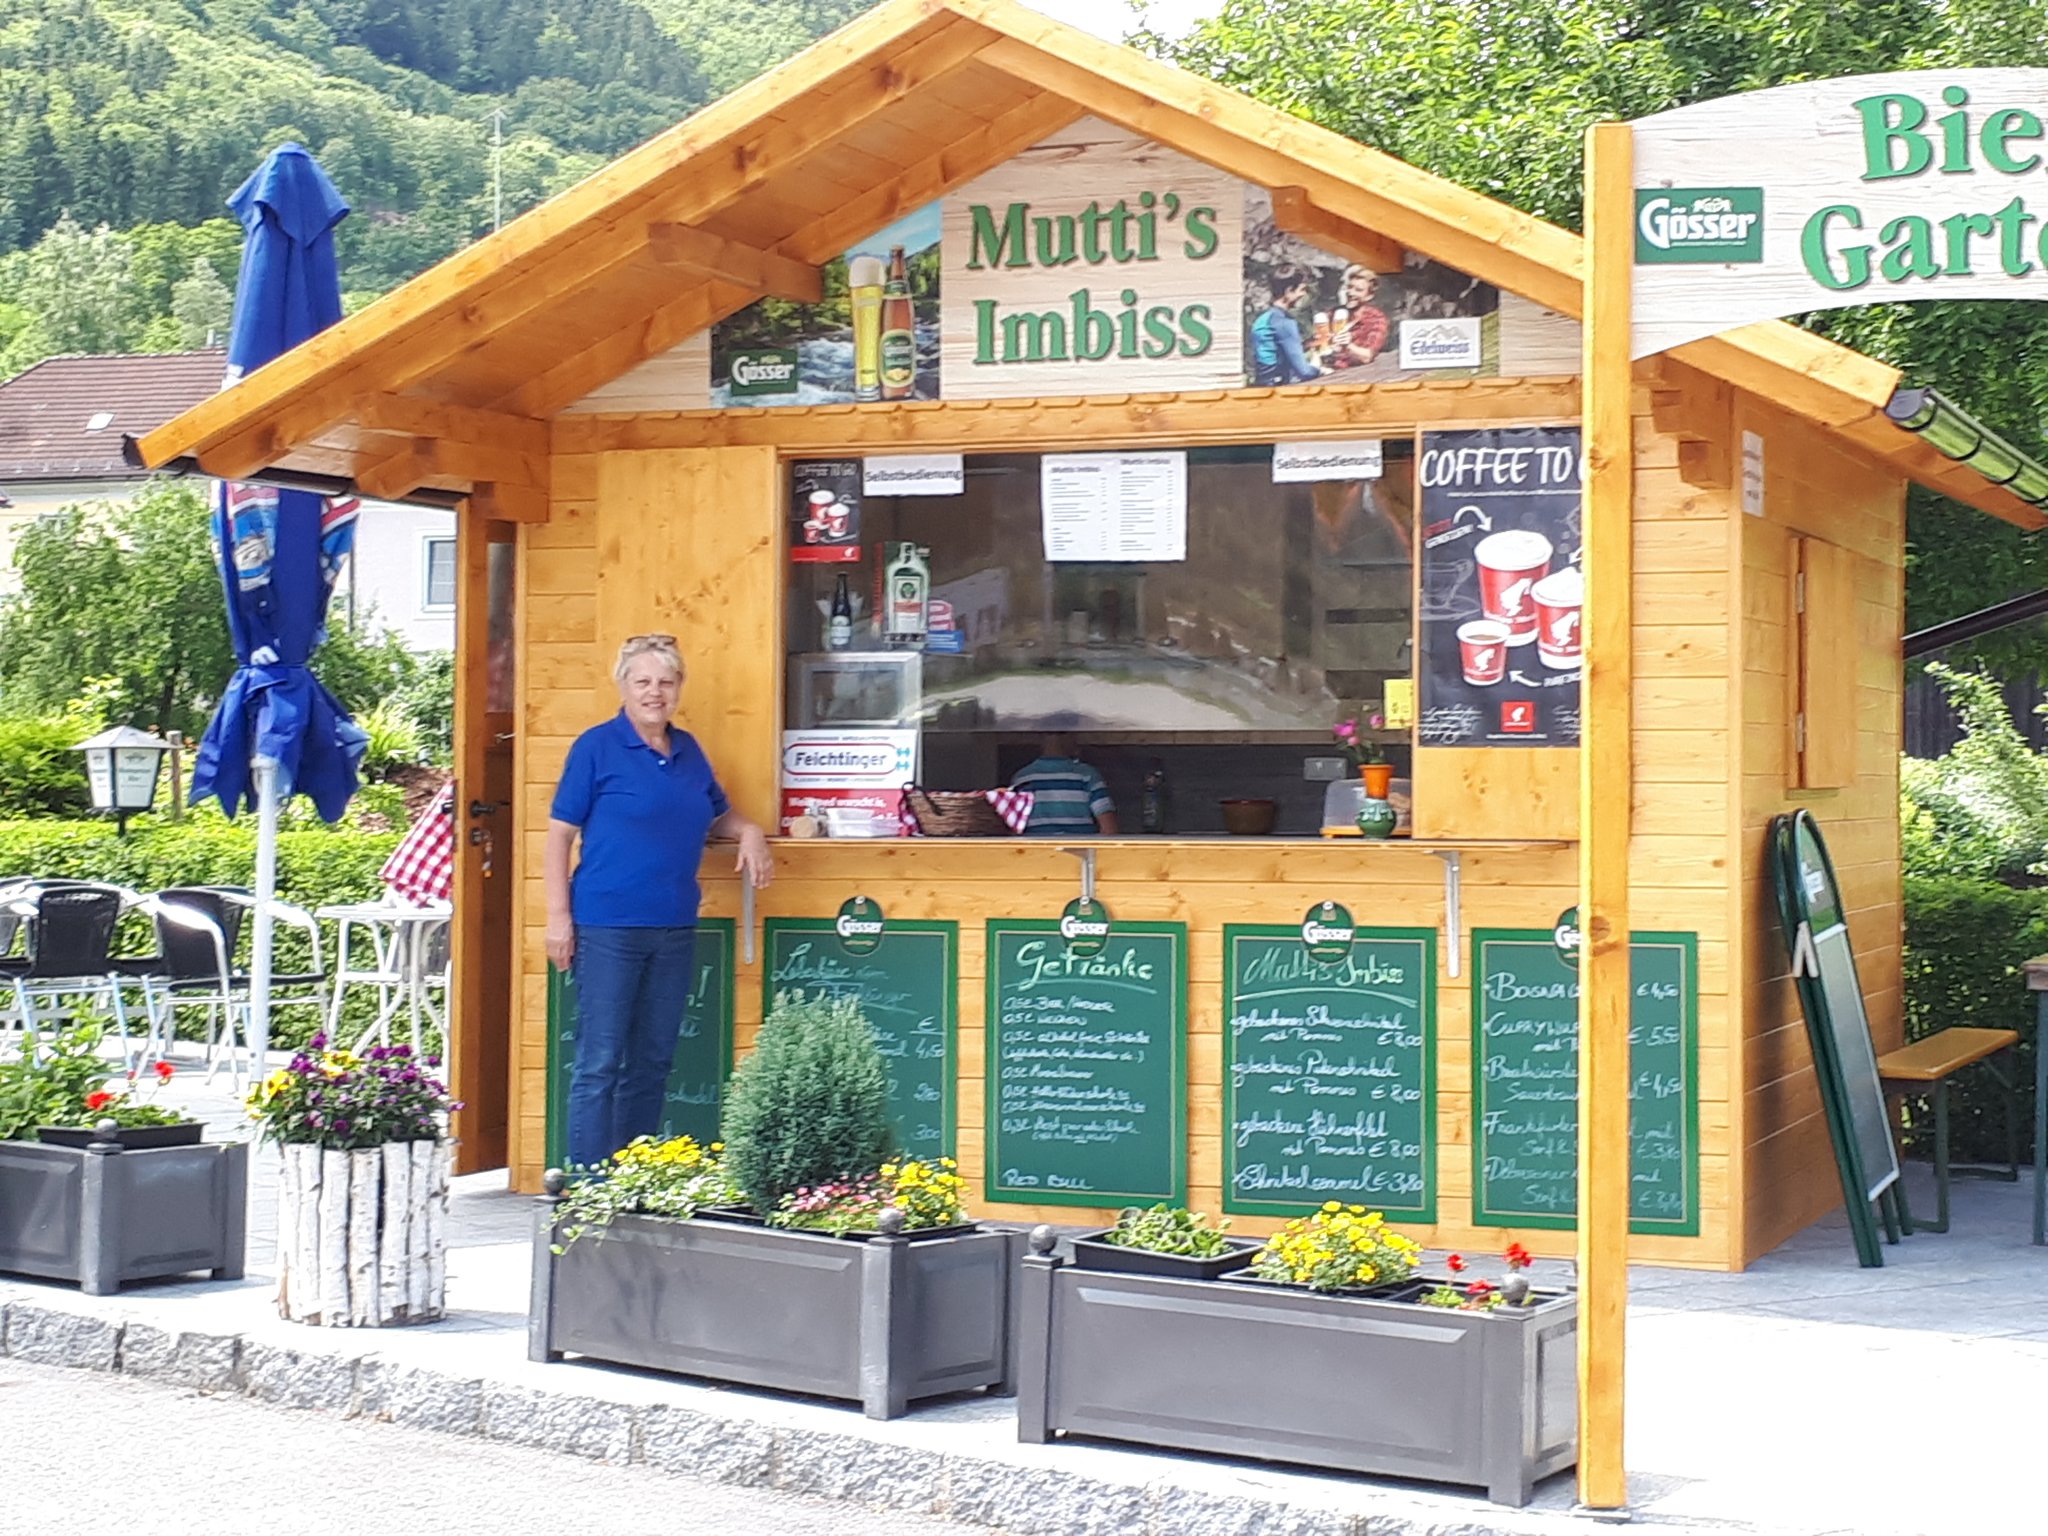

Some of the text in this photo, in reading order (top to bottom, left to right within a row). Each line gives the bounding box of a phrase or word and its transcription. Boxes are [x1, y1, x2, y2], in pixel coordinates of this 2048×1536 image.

[1852, 85, 2048, 182] Bie
[967, 191, 1219, 270] Mutti's
[1640, 197, 1757, 249] Gösser
[1801, 196, 2048, 291] Gart
[972, 288, 1214, 366] Imbiss
[731, 355, 796, 387] Gösser
[1420, 446, 1573, 488] COFFEE TO
[793, 751, 888, 770] Feichtinger
[1017, 941, 1153, 991] Getränke
